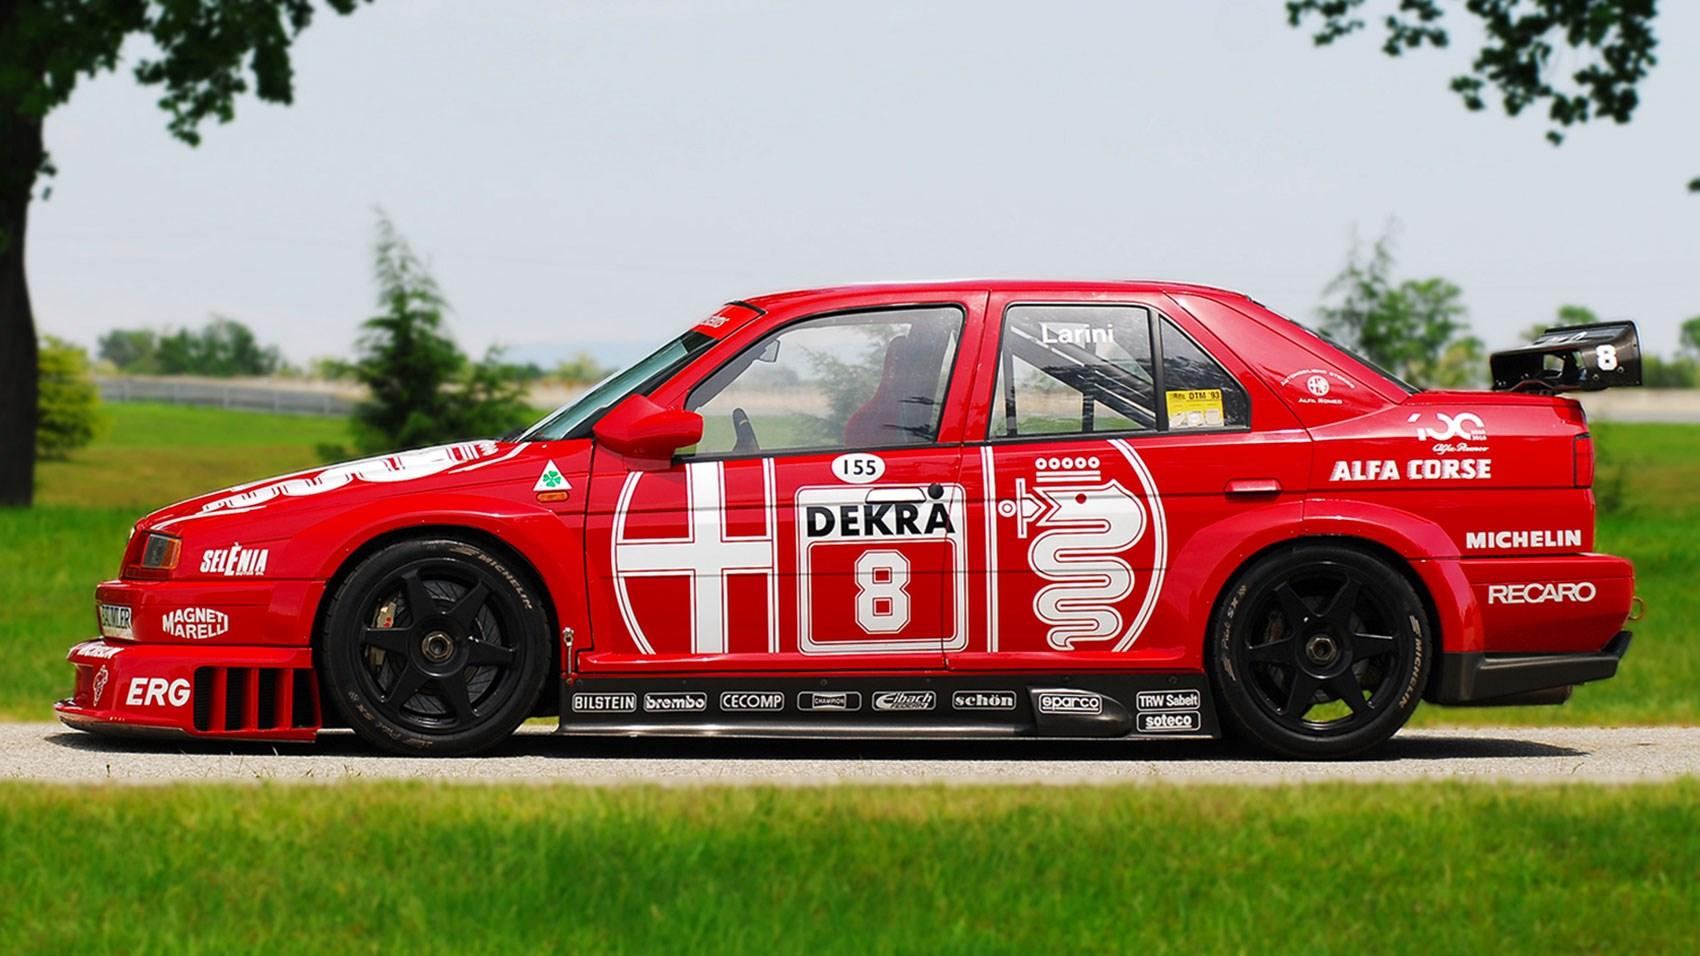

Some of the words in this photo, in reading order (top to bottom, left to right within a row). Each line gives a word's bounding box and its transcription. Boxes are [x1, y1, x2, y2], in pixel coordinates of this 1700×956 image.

[1041, 322, 1114, 343] Larini
[1596, 344, 1618, 371] 8
[844, 459, 876, 475] 155
[1329, 460, 1400, 482] ALFA
[1407, 459, 1492, 480] CORSE
[806, 503, 956, 537] DEKRA
[1466, 530, 1582, 549] MICHELIN
[478, 554, 533, 610] MICHELIN
[854, 549, 911, 635] 8
[1488, 582, 1597, 604] RECARO
[162, 607, 229, 631] MAGNETI
[162, 616, 229, 639] MARELLI
[125, 677, 191, 707] ERG
[574, 695, 635, 709] BILSTEIN
[646, 694, 705, 709] brembo
[722, 694, 782, 708] CECOMP
[955, 694, 1014, 707] schön
[1139, 694, 1165, 707] TRW
[1166, 692, 1198, 706] Sabelt
[1042, 696, 1099, 710] sparco
[1145, 714, 1192, 728] soteco
